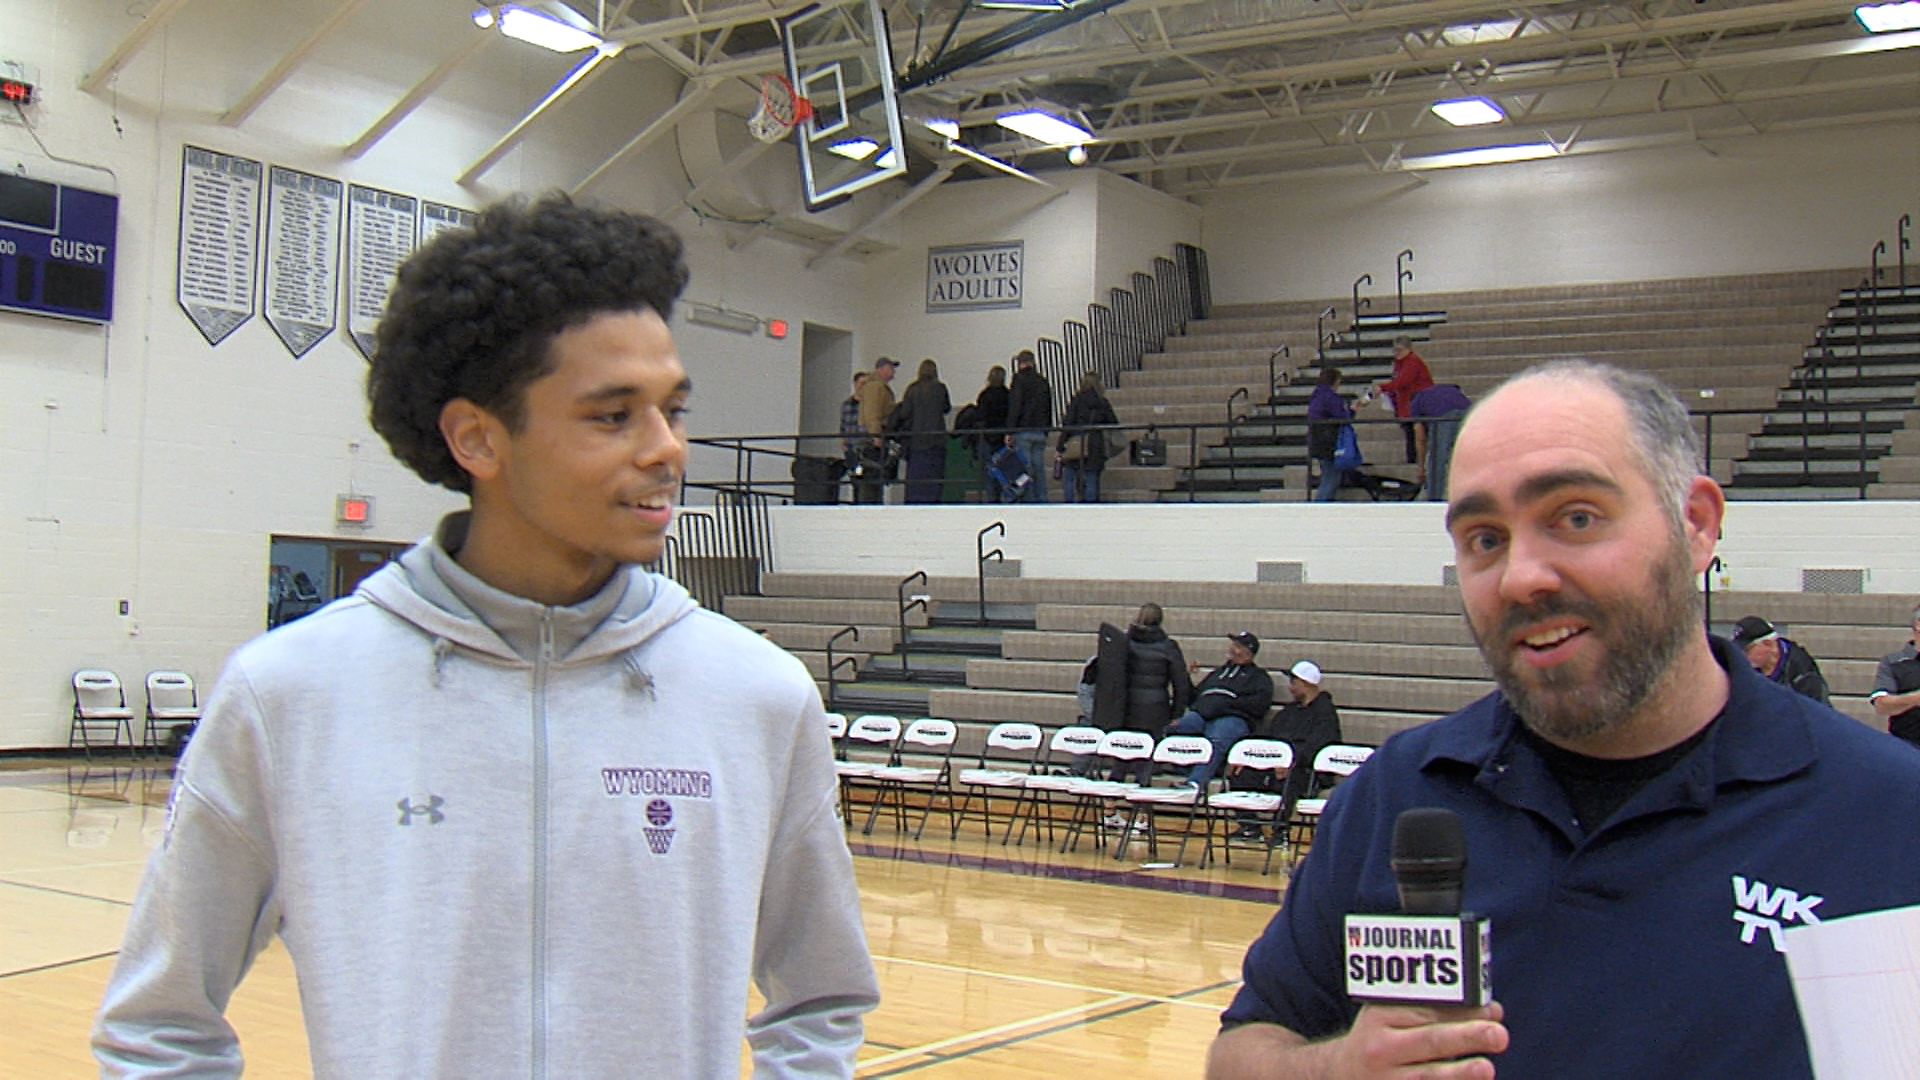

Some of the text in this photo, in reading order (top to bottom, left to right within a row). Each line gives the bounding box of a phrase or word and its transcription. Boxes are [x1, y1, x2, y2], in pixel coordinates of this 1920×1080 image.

[50, 237, 106, 264] GUEST
[934, 251, 1018, 276] WOLVES
[931, 276, 1018, 301] ADULTS
[601, 767, 712, 798] WYOMING
[1732, 875, 1824, 926] WK
[1364, 926, 1456, 950] JOURNAL
[1350, 953, 1459, 986] sports
